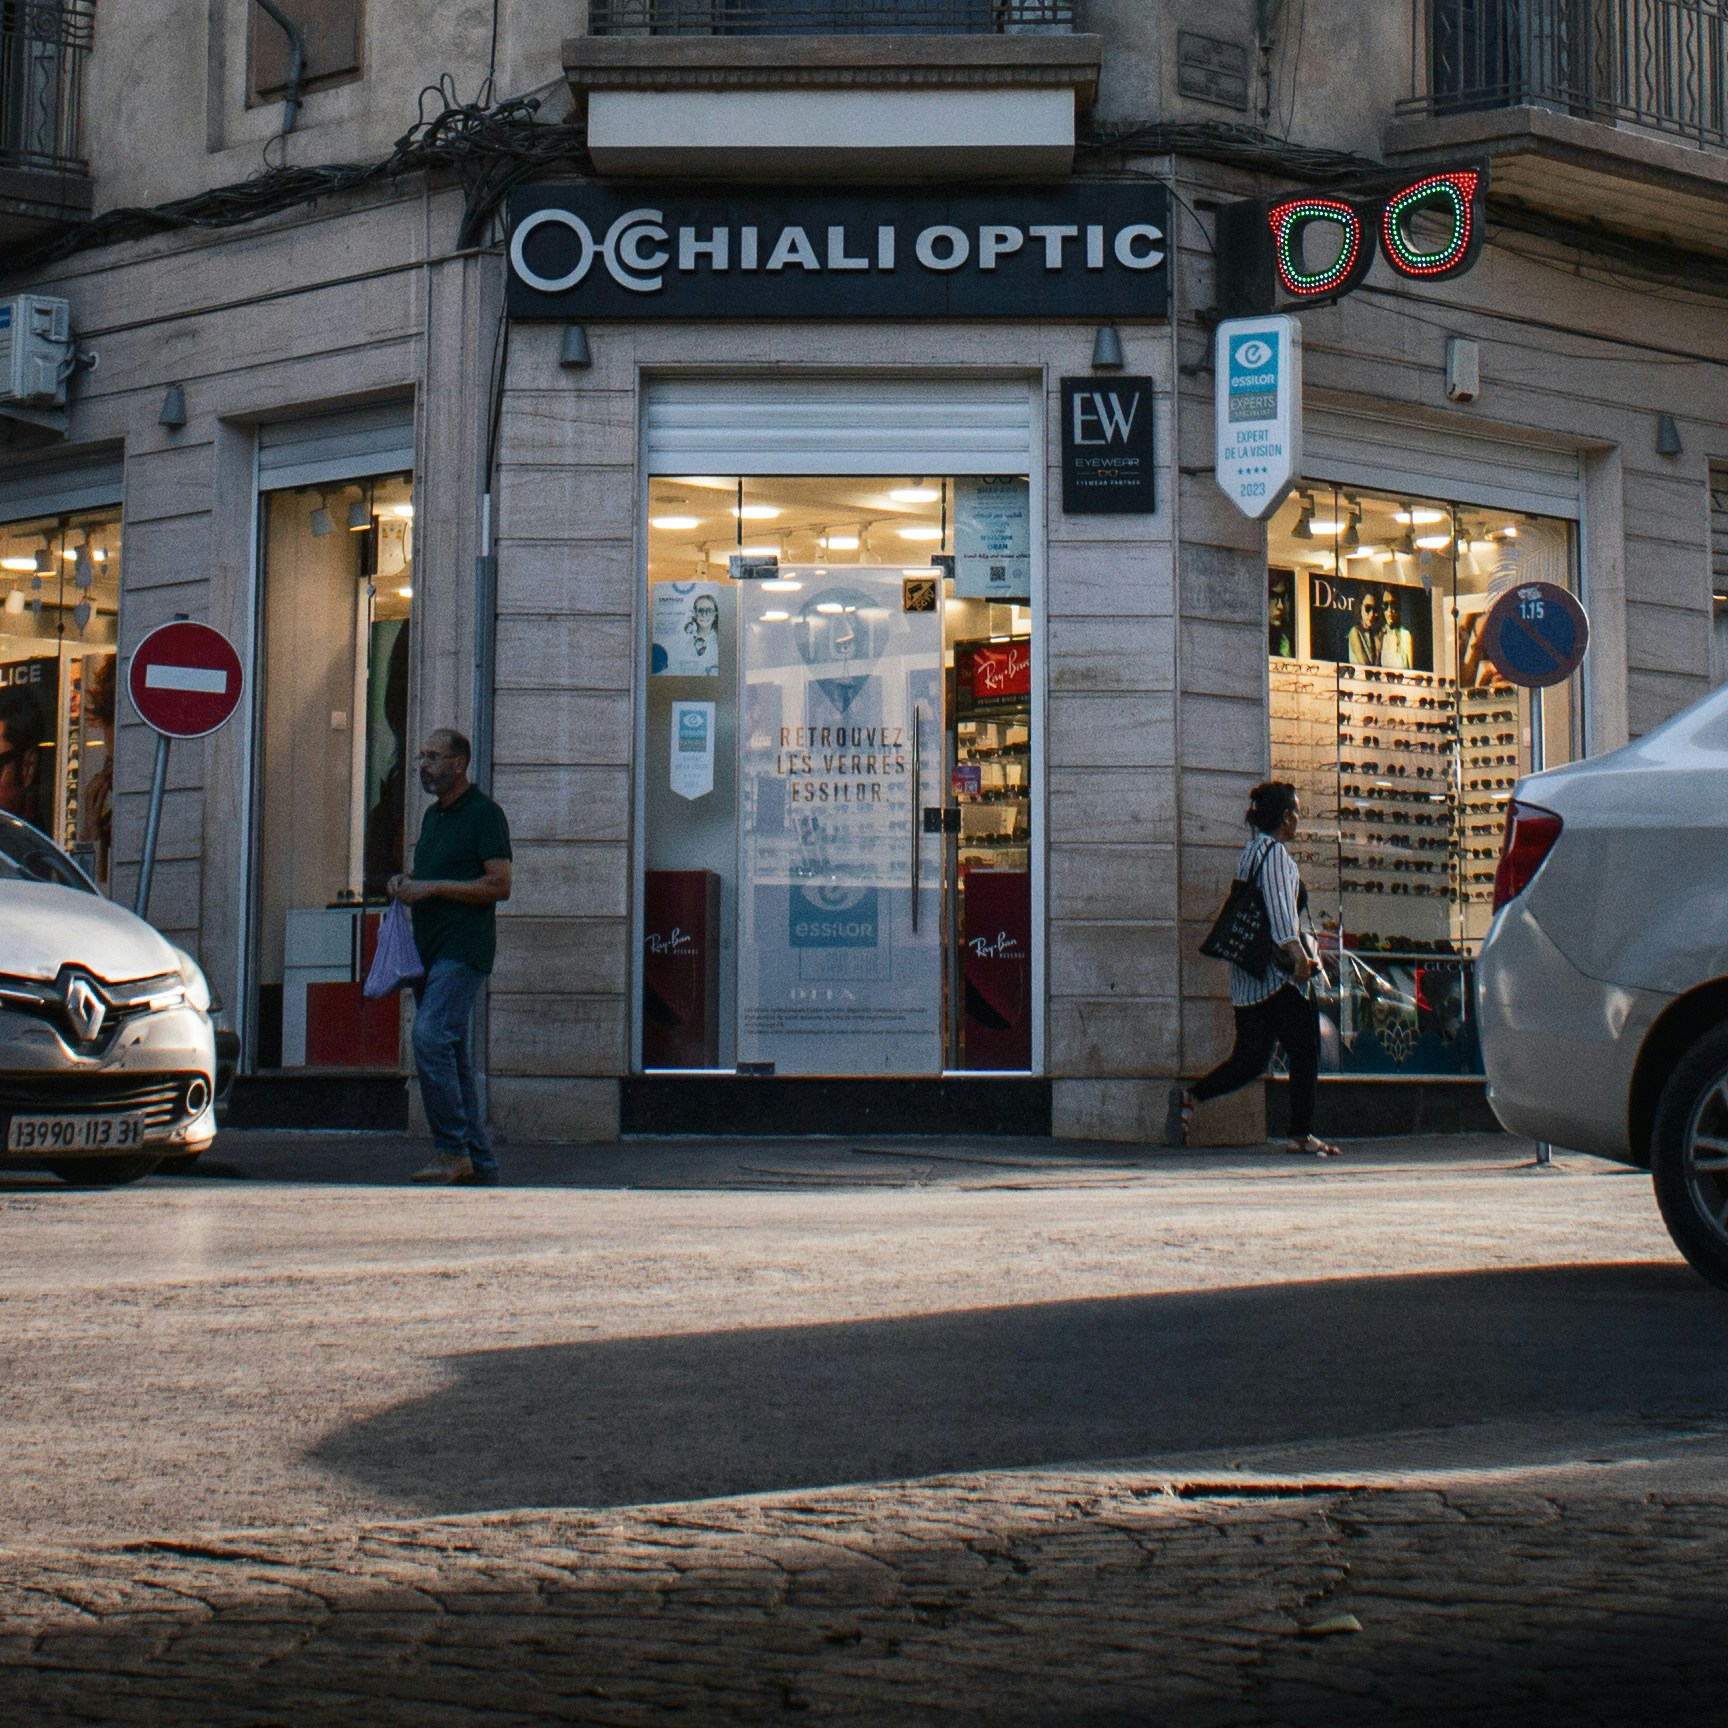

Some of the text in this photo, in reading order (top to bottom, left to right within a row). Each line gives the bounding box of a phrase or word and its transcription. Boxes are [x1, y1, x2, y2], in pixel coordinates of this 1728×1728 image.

[916, 222, 1165, 272] OPTIC
[1230, 395, 1275, 411] EXPERTS
[1073, 391, 1140, 445] EW
[1236, 429, 1270, 443] EXPERT
[1224, 444, 1282, 460] DE LA VISION
[1075, 457, 1140, 468] EYEWEAR
[1076, 479, 1141, 487] EYEWEAR PARTNER
[1240, 483, 1266, 497] 2023
[1312, 579, 1355, 611] Dior
[779, 726, 903, 748] RETROUVEZ
[777, 754, 905, 775] LES VERRES
[1424, 961, 1474, 973] GUCCI
[15, 1120, 139, 1148] 13990 113 31
